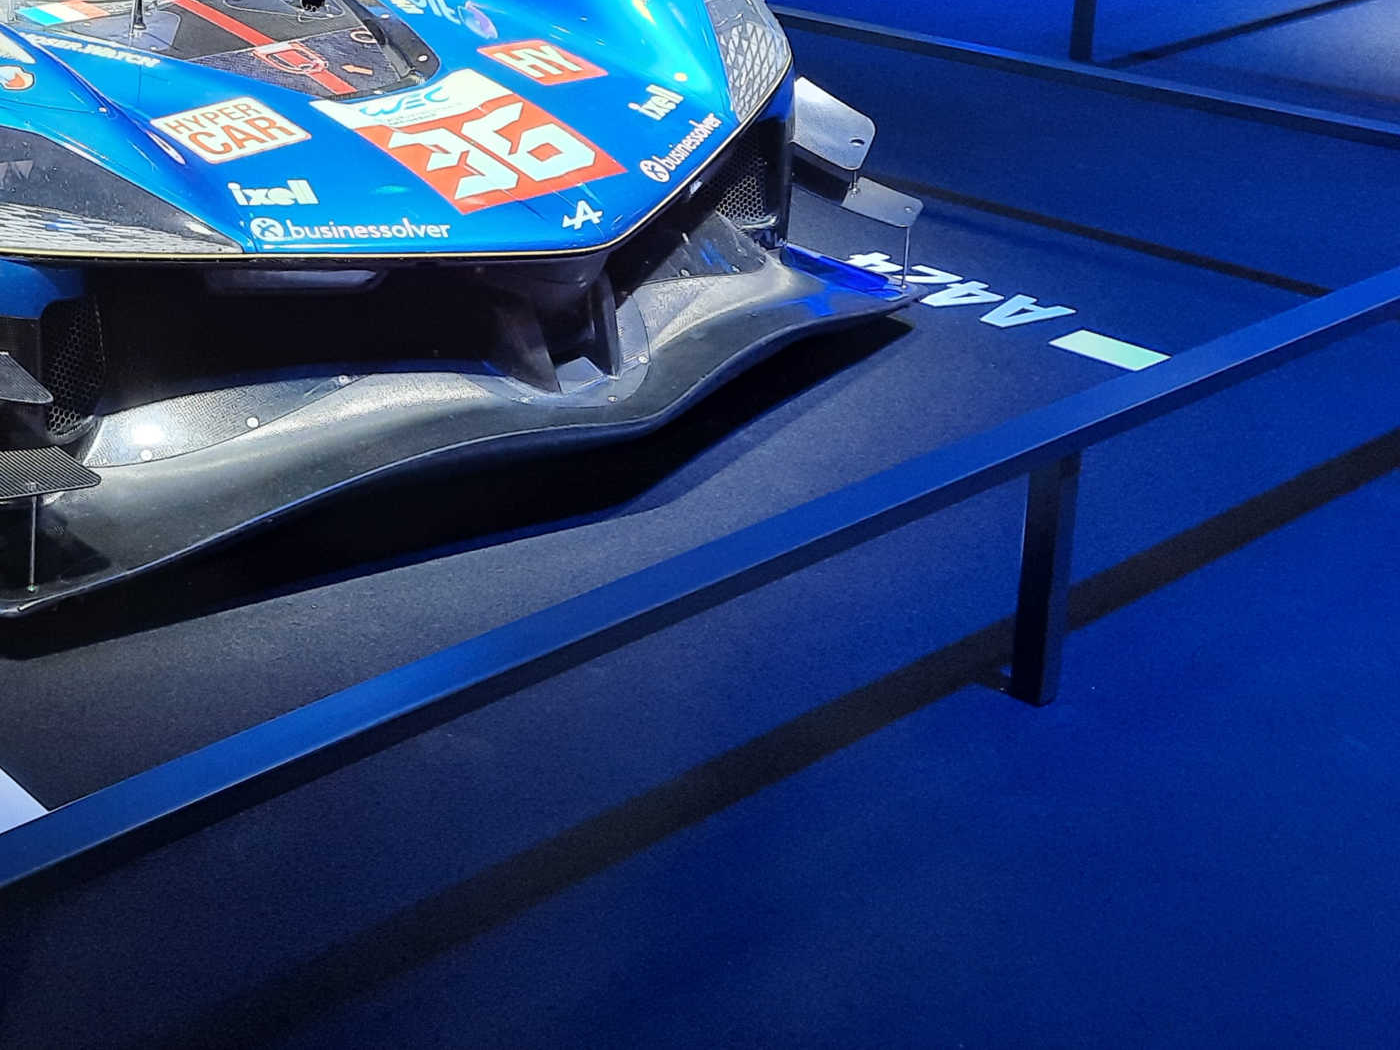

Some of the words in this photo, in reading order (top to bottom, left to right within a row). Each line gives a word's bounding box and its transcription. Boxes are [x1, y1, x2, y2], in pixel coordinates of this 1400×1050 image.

[493, 45, 582, 78] HY
[360, 86, 449, 117] WEC
[628, 84, 685, 121] ixell
[164, 103, 257, 134] HYPER
[188, 118, 296, 155] CAR
[387, 102, 596, 200] 36
[652, 112, 723, 172] businessolver
[227, 179, 320, 206] ixell
[286, 217, 451, 239] businessolver
